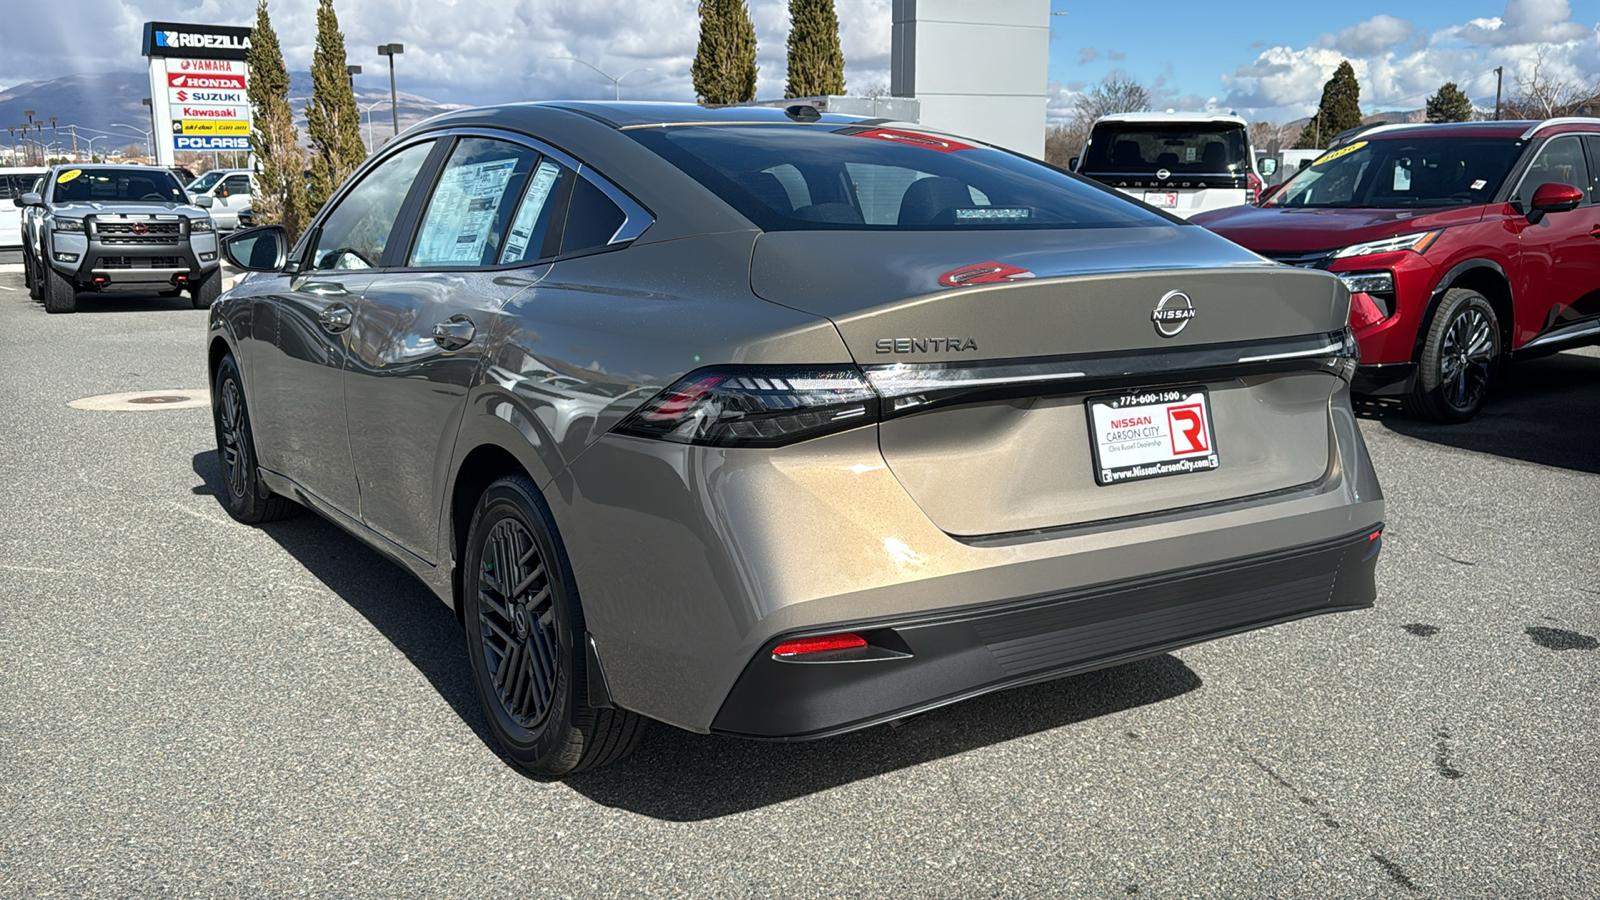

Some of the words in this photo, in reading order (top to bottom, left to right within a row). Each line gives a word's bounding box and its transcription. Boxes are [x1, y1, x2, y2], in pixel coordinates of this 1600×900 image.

[179, 33, 252, 49] RIDEZILLA
[191, 59, 232, 72] YAMAHA
[186, 78, 242, 88] HONDA
[192, 92, 241, 102] SUZUKI
[183, 107, 237, 117] Kawasaki
[177, 137, 249, 148] POLARIS
[1153, 309, 1196, 320] NISSAN
[875, 336, 978, 354] SENTRA
[1120, 390, 1180, 406] 775-600-1500
[1110, 415, 1152, 429] NISSAN
[1106, 428, 1141, 442] CARSON
[1142, 426, 1160, 438] CITY
[1112, 459, 1209, 480] www.NissanCarsonCity.com
